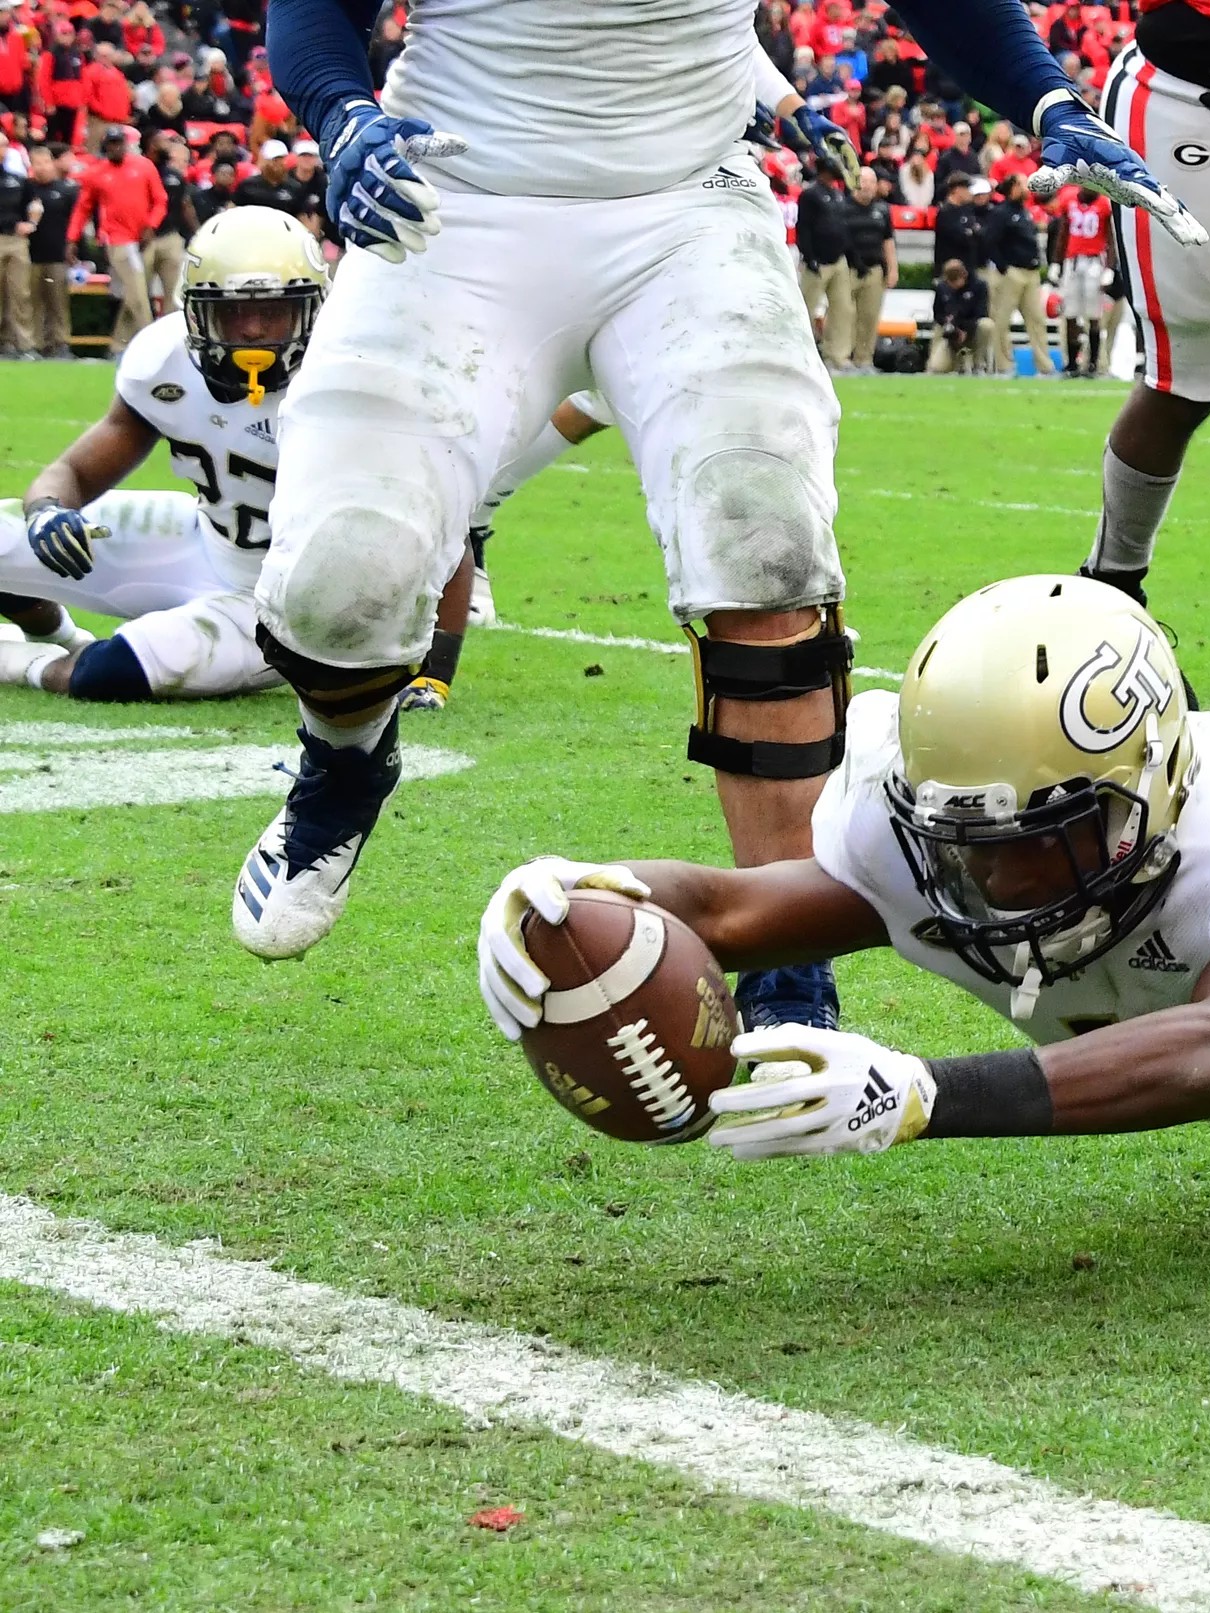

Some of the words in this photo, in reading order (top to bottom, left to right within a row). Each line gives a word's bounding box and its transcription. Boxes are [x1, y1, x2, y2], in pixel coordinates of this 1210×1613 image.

[1173, 143, 1210, 167] G
[702, 178, 757, 188] adidas
[944, 793, 987, 808] ACC
[1128, 957, 1190, 973] adidas
[847, 1090, 900, 1132] adida
